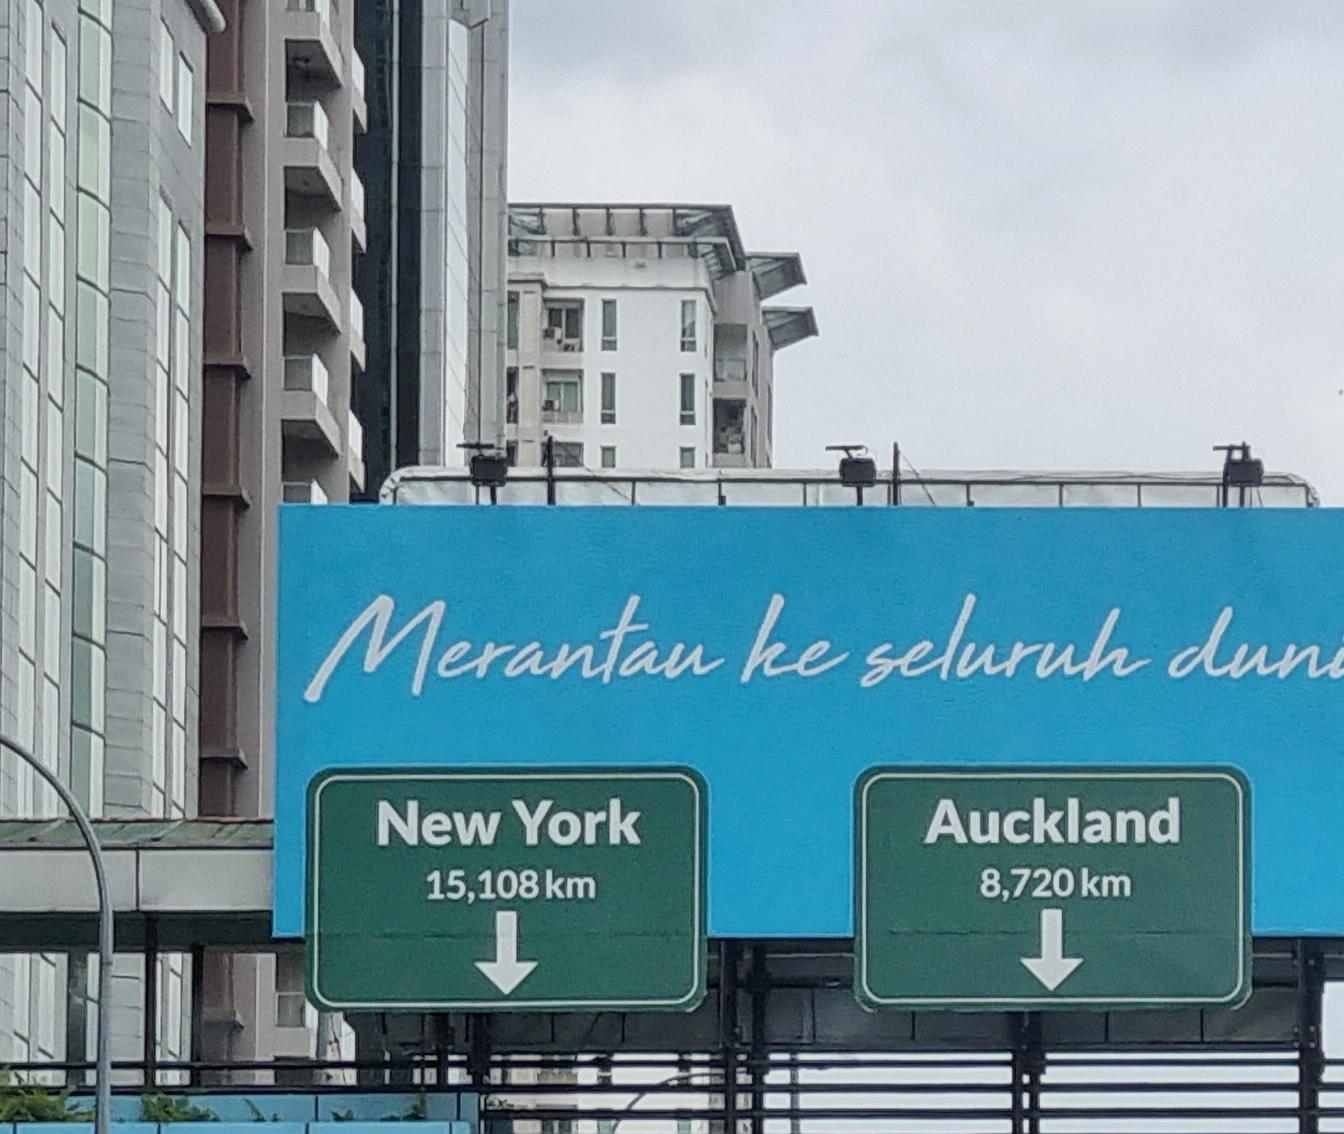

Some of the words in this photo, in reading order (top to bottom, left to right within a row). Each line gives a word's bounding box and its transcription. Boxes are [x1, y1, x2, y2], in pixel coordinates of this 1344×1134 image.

[303, 593, 727, 703] Merantau
[740, 593, 848, 683] ke
[858, 593, 1153, 688] seluruh
[377, 799, 502, 847] New
[511, 797, 642, 847] York
[924, 796, 1181, 845] Auckland
[426, 868, 540, 905] 15,108
[545, 868, 597, 900] km
[980, 866, 1075, 903] 8,720
[1080, 866, 1132, 898] km
